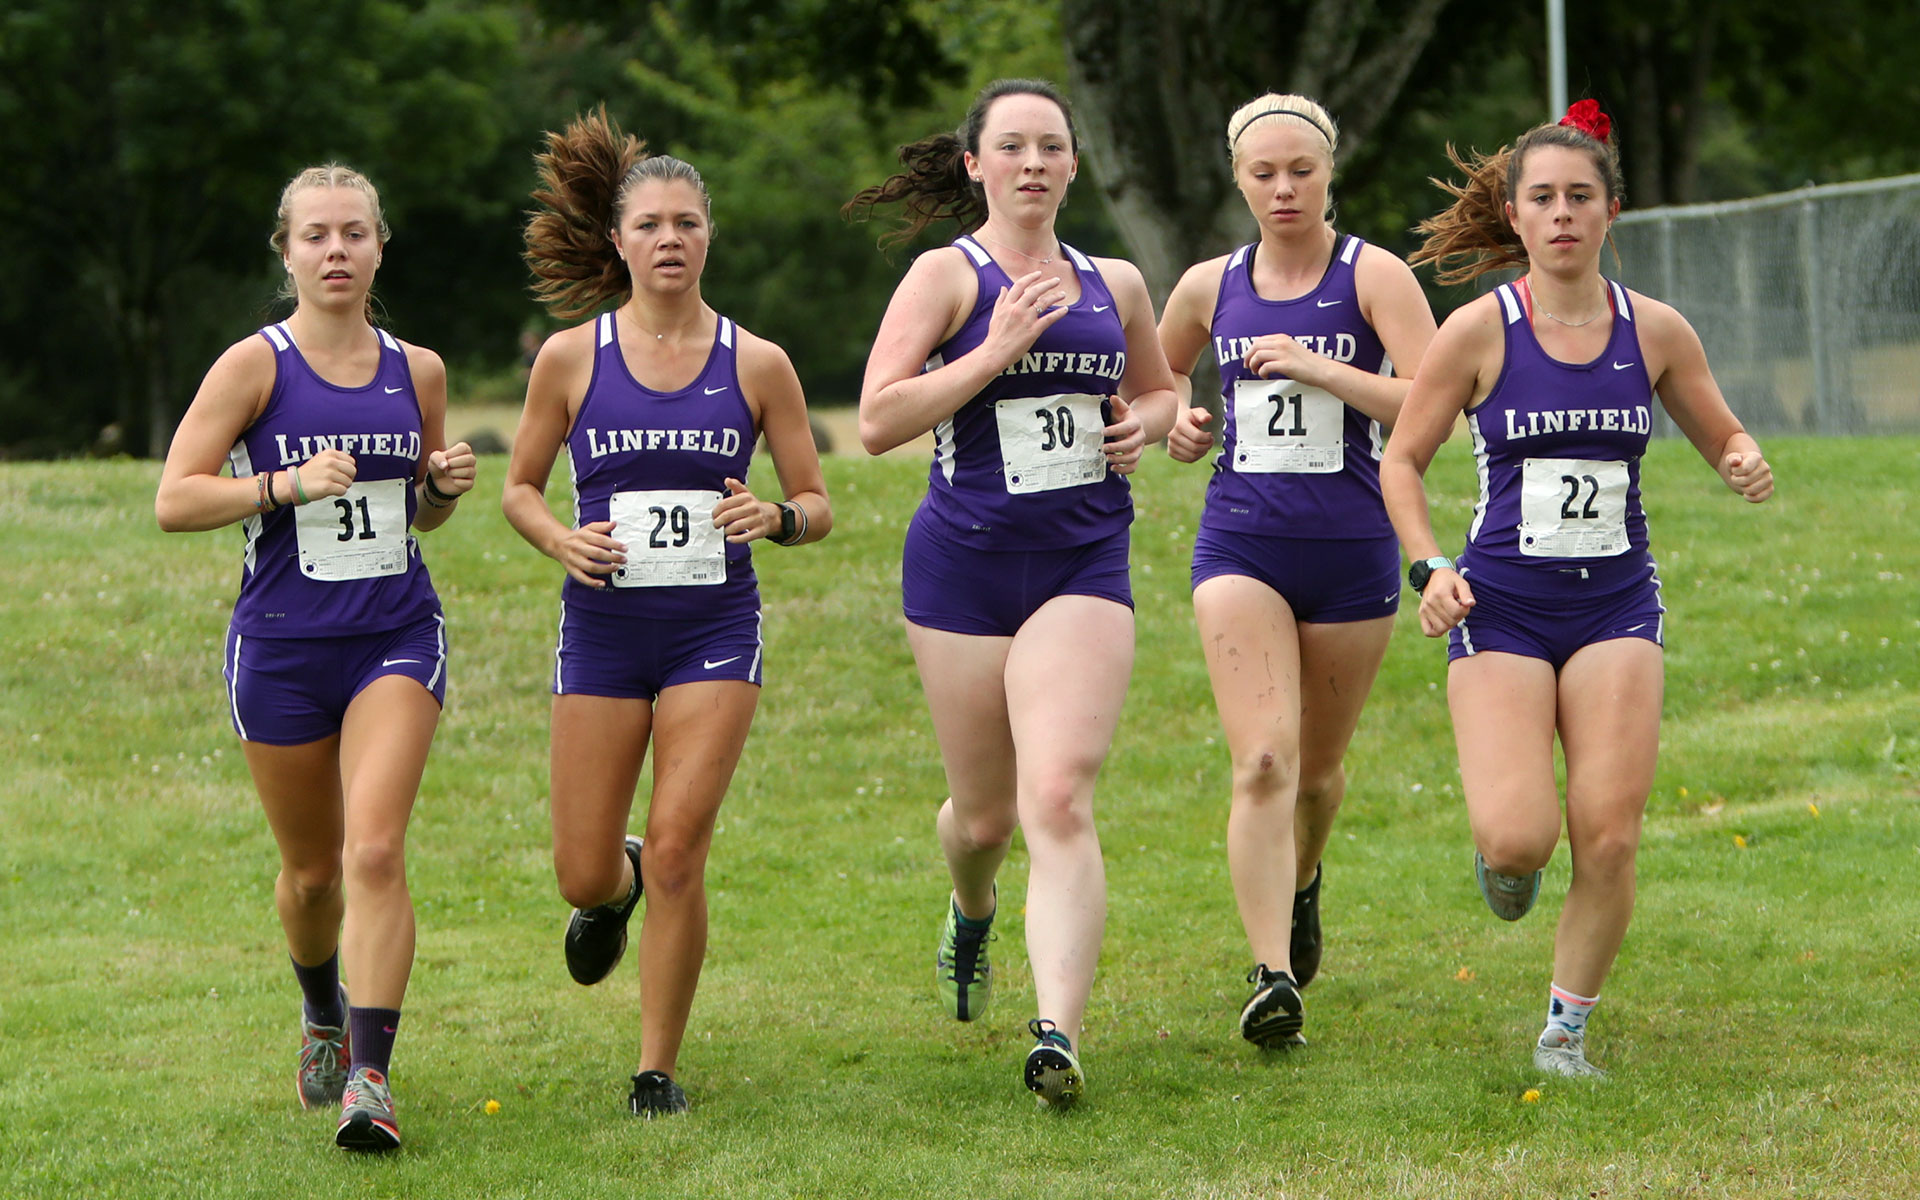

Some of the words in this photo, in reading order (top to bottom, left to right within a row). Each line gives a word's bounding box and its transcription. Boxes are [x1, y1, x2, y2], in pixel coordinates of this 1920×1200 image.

[1216, 333, 1357, 366] LINELD
[1035, 405, 1075, 451] 30
[1268, 394, 1307, 436] 21
[1504, 405, 1650, 440] LINFIELD
[275, 431, 421, 466] LINFIELD
[587, 427, 740, 459] LINFIELD
[1561, 474, 1599, 520] 22
[334, 496, 376, 542] 31
[648, 505, 690, 549] 29
